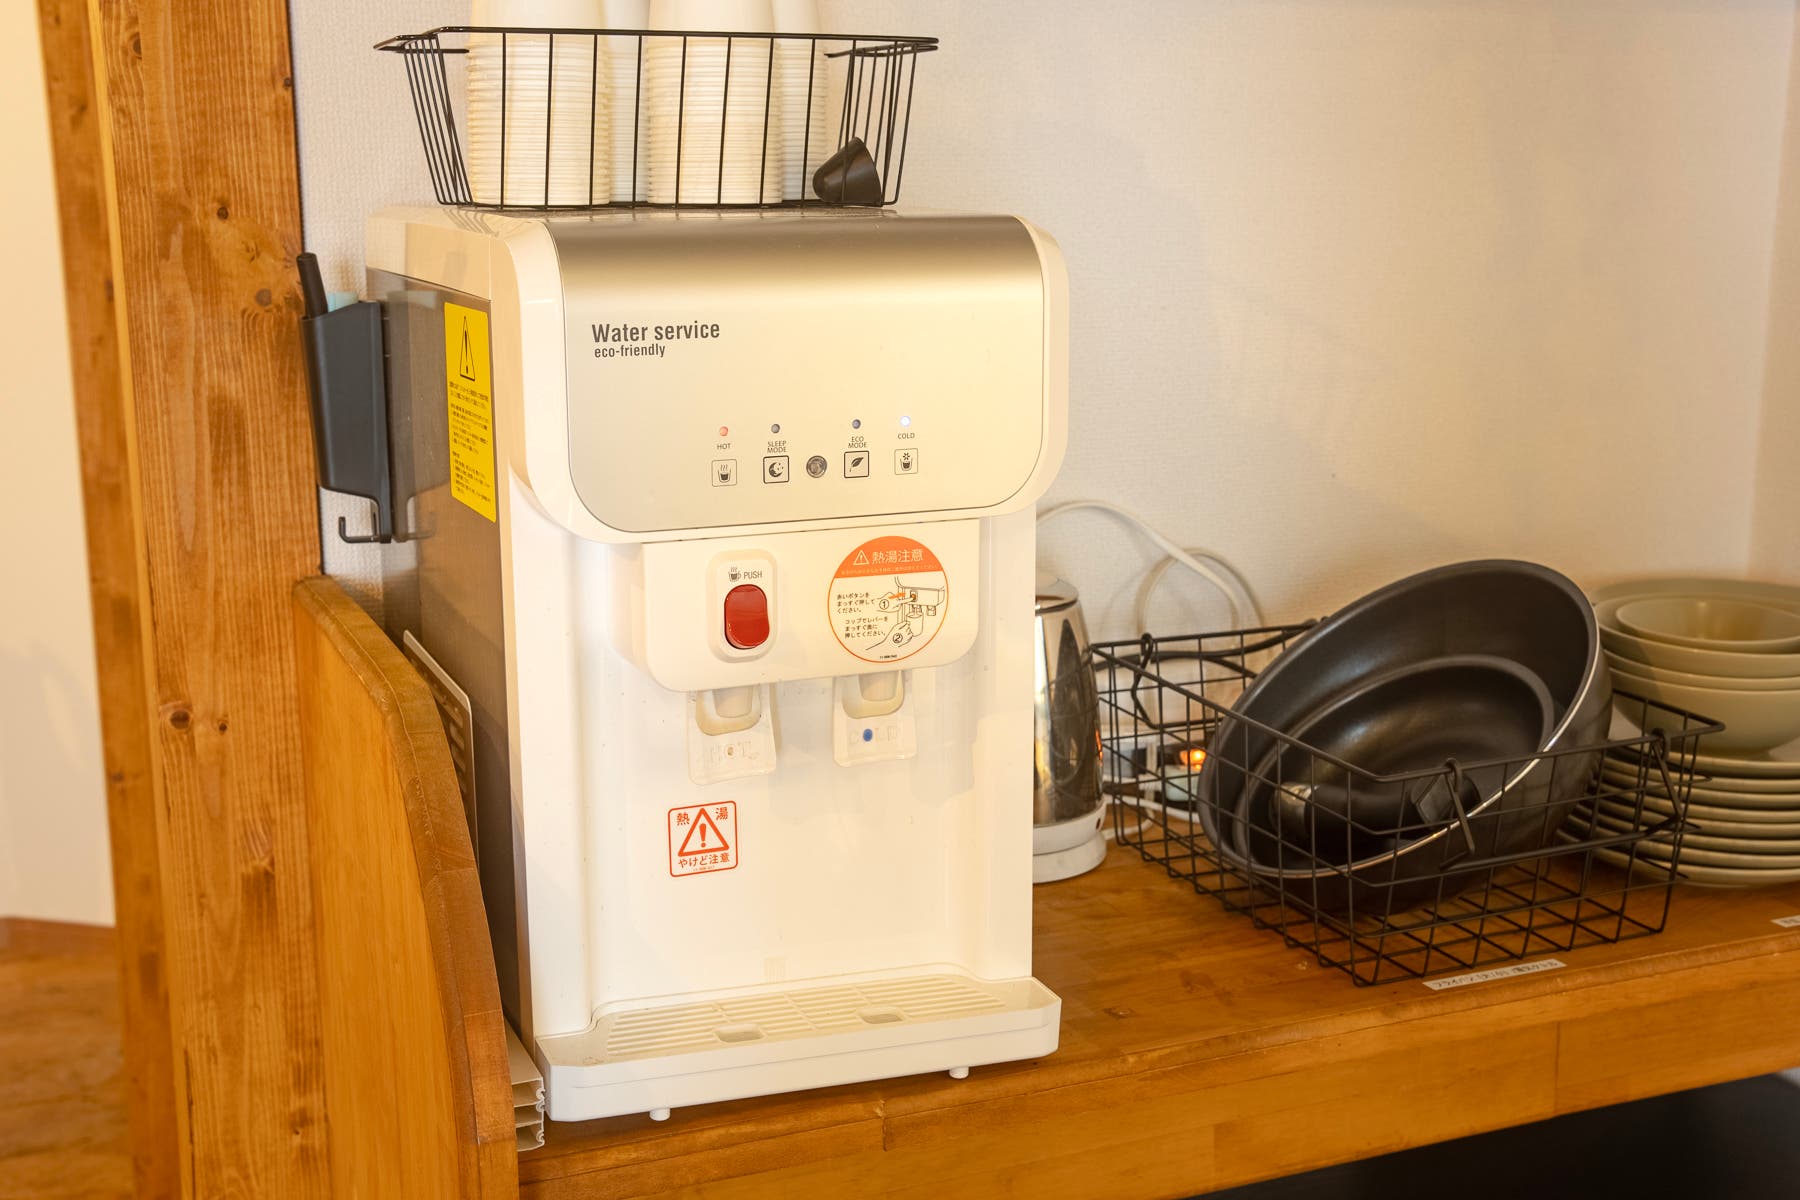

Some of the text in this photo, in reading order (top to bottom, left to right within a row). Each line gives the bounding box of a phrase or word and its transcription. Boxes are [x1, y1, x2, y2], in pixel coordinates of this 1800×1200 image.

[591, 320, 720, 342] Water service
[594, 343, 666, 358] eco-friendly
[851, 435, 865, 443] ECO
[897, 432, 915, 440] COLD
[716, 442, 731, 450] HOT
[848, 441, 867, 449] MODE
[767, 446, 787, 454] MODE
[872, 548, 924, 565] 熱湯注意
[743, 571, 763, 580] PUSH
[678, 852, 730, 869] やけど注意
